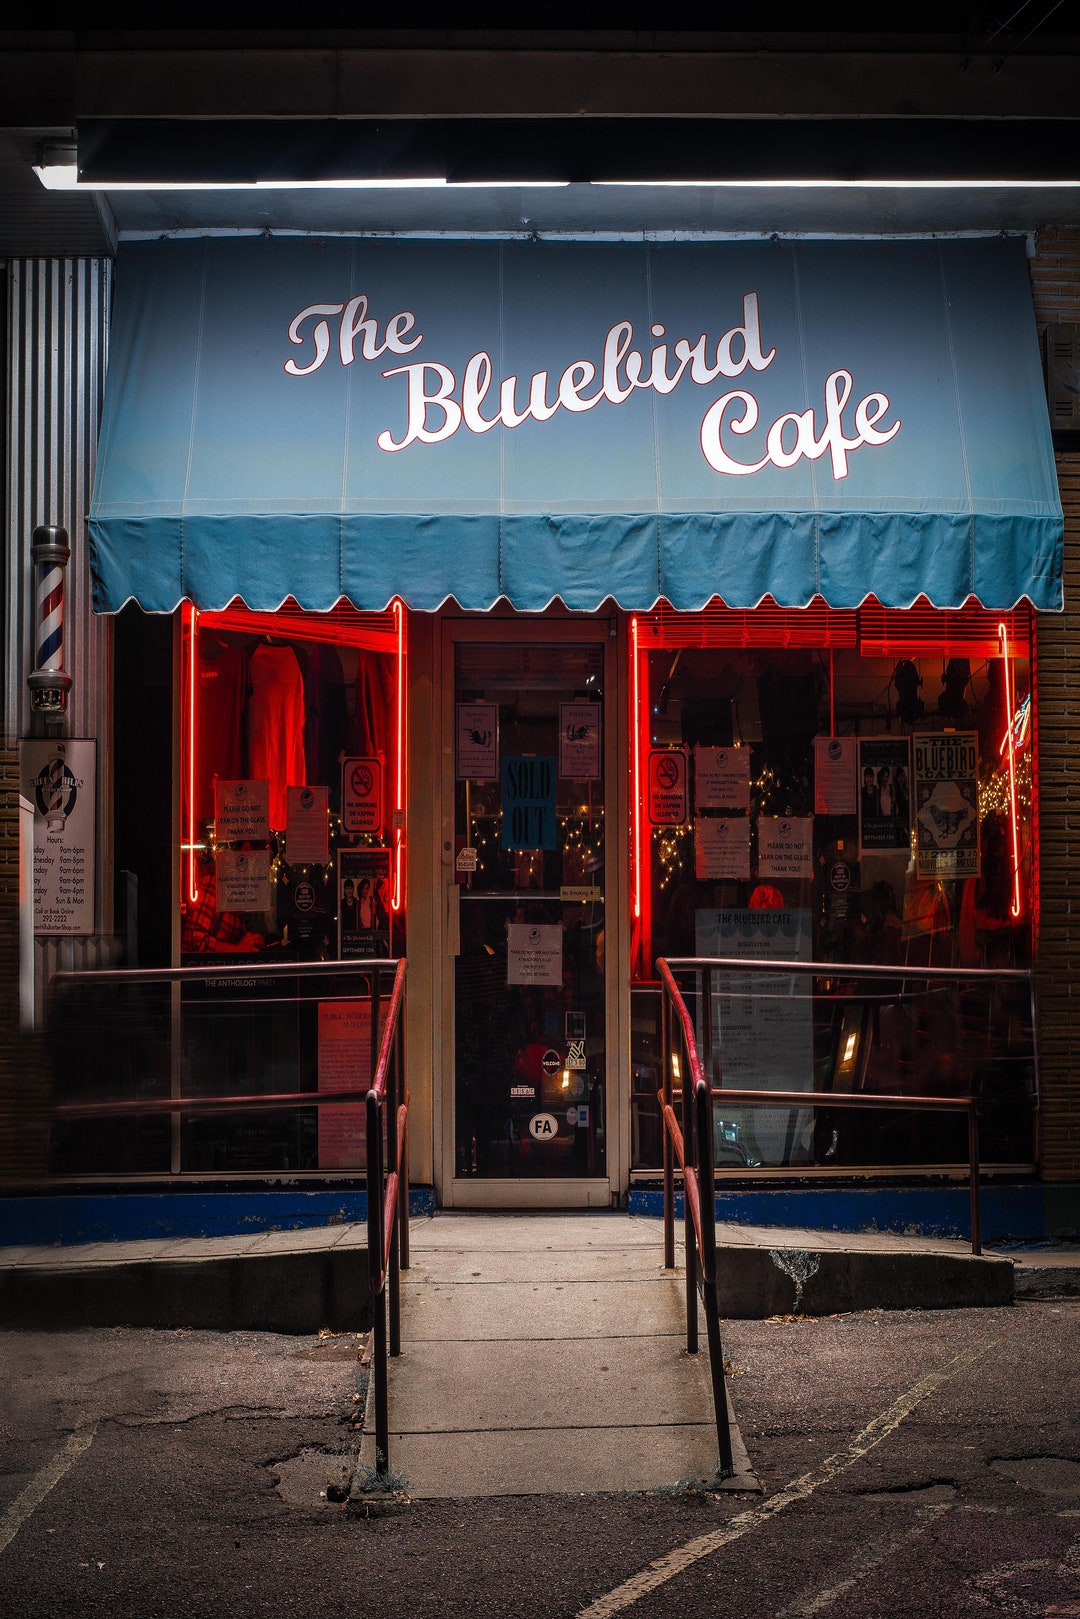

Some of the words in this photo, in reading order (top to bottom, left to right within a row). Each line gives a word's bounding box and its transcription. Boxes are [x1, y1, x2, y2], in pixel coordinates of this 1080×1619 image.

[283, 294, 424, 376] The
[377, 292, 776, 453] Bluebird
[699, 369, 902, 480] Cafe
[916, 747, 976, 772] BLUEBIRD
[925, 770, 968, 779] CAFE
[507, 761, 551, 800] SOLD
[224, 805, 241, 813] PLEASE
[512, 806, 547, 844] OUT
[46, 836, 64, 844] Hours:
[60, 846, 84, 854] 9am-6pm
[60, 856, 84, 864] 9am-8pm
[60, 866, 84, 874] 9am-6pm
[59, 876, 84, 885] 9am-6pm
[59, 886, 84, 895] 9am-4pm
[718, 914, 732, 924] THE
[734, 914, 771, 925] BLUEBIRD
[773, 913, 791, 925] CAFE
[535, 1121, 552, 1134] FA
